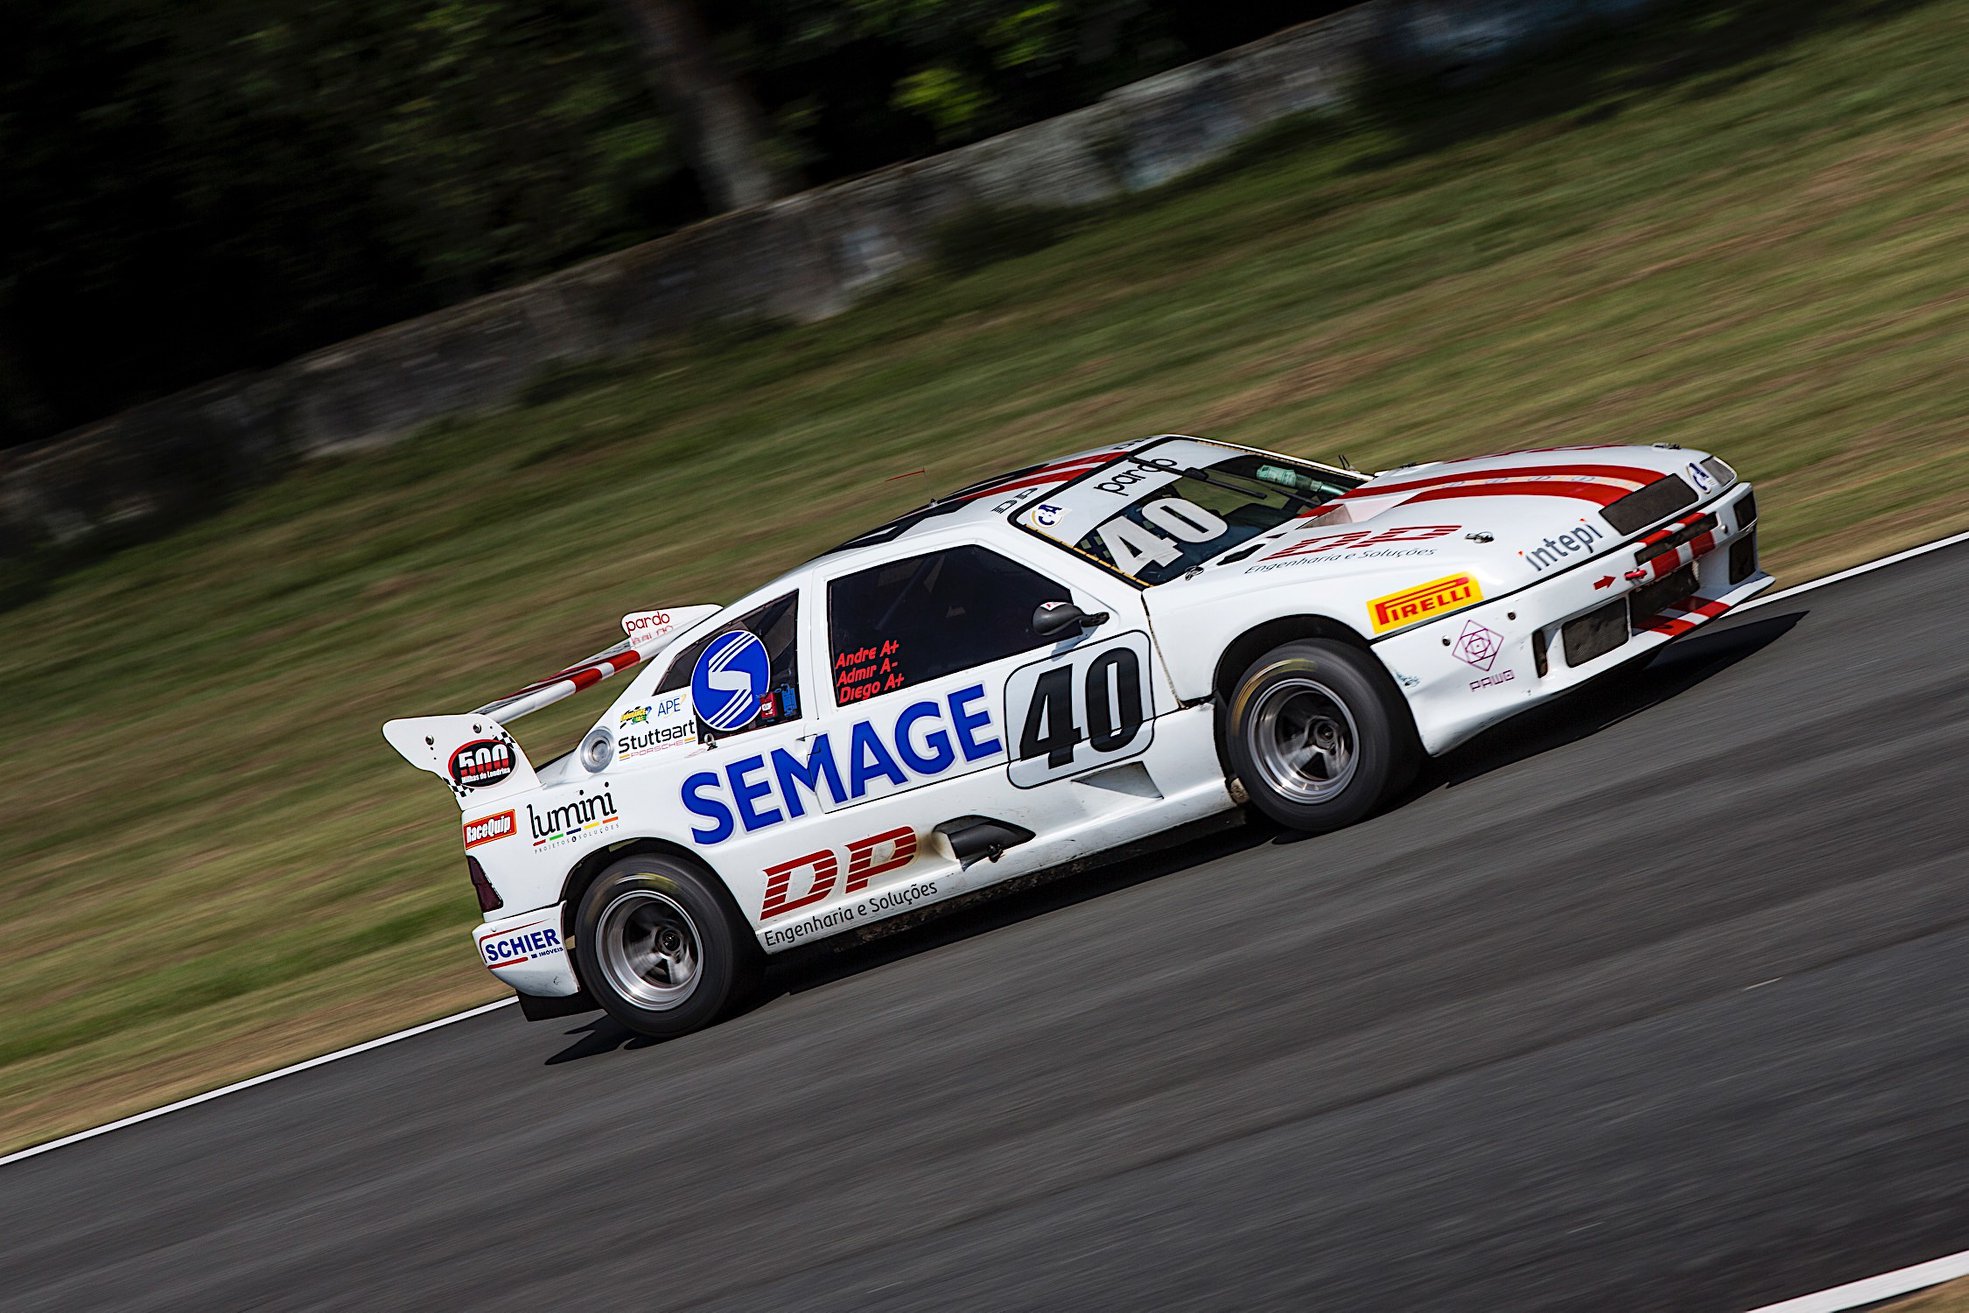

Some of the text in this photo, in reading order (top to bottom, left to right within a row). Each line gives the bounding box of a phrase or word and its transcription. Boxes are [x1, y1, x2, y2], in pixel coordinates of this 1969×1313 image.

[1093, 459, 1177, 496] pardo
[1096, 497, 1228, 577] 40
[1518, 518, 1603, 571] intepi
[1244, 554, 1342, 574] Engenharia
[1360, 547, 1437, 559] Soluções
[1375, 577, 1471, 625] PIRELLI
[625, 611, 670, 634] pardo
[835, 640, 900, 669] Andre A+
[836, 658, 898, 687] Admir A-
[839, 673, 904, 703] Diego A+
[658, 698, 680, 716] APE
[1020, 646, 1143, 769] 40
[618, 719, 695, 754] Stuttgart
[631, 740, 684, 757] PORSCHE
[458, 744, 509, 777] 500
[680, 684, 1002, 845] SEMAGE
[527, 781, 617, 839] lumini
[466, 815, 511, 844] RaceQuip
[759, 826, 918, 921] DP
[764, 882, 937, 946] Engenharia e Soluções
[485, 929, 560, 961] SCHIER
[539, 947, 564, 957] IMÓVEIS
